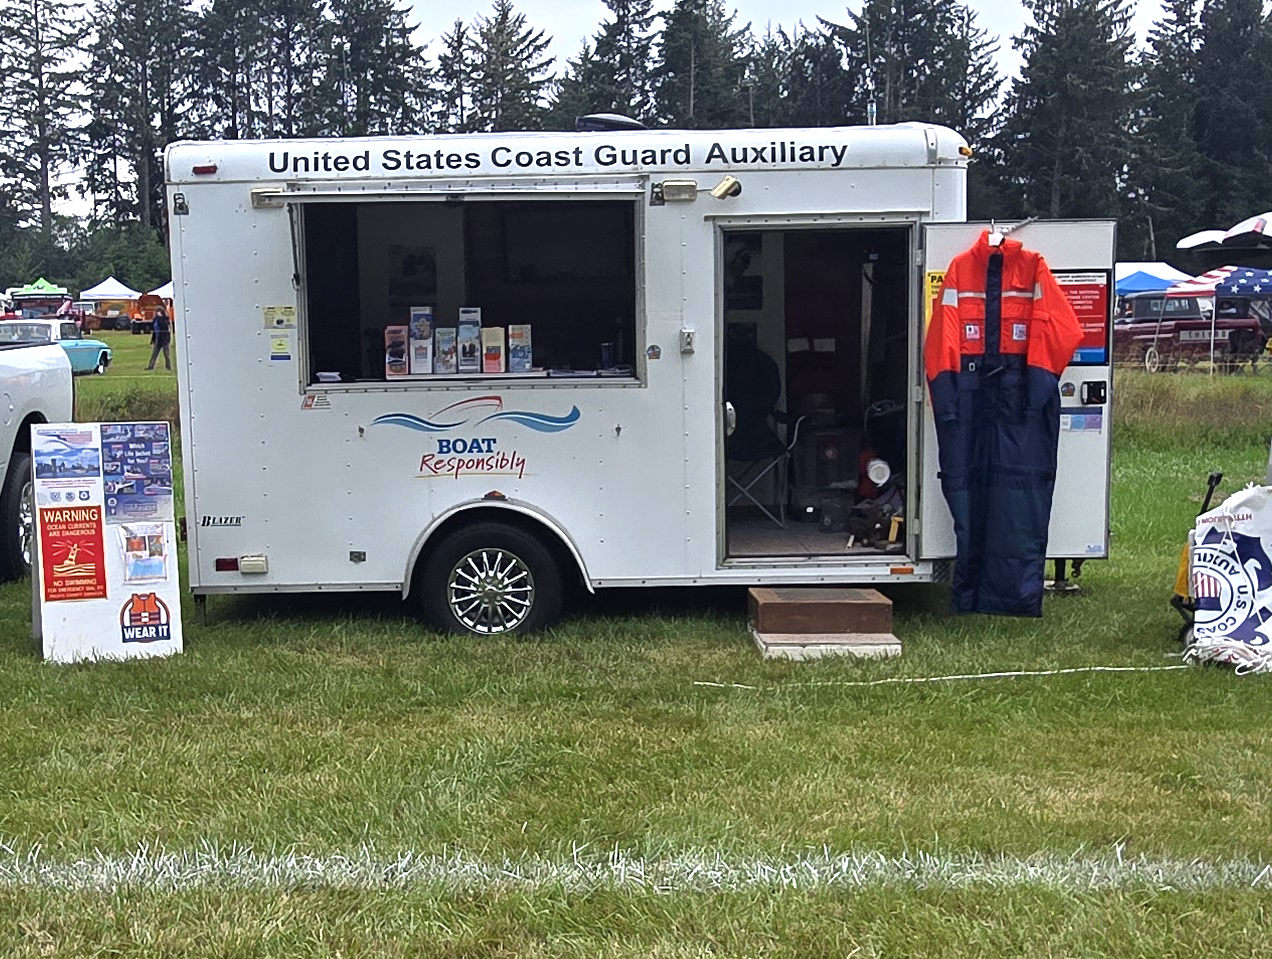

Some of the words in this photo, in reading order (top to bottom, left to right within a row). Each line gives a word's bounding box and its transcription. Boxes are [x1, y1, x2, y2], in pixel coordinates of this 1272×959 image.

[268, 150, 370, 173] United
[381, 149, 480, 171] States
[491, 147, 583, 168] Coast
[594, 144, 691, 166] Guard
[704, 141, 848, 168] Auxiliary
[437, 438, 497, 455] BOAT
[419, 451, 526, 480] Responsibly
[43, 508, 99, 523] WARNING
[61, 529, 96, 537] DANGEROUS
[67, 522, 97, 530] CURRENTS
[65, 578, 97, 586] SWIMMING
[1233, 584, 1249, 612] U.S.
[123, 626, 157, 640] WEAR
[158, 625, 169, 637] IT
[1196, 615, 1237, 634] COAS
